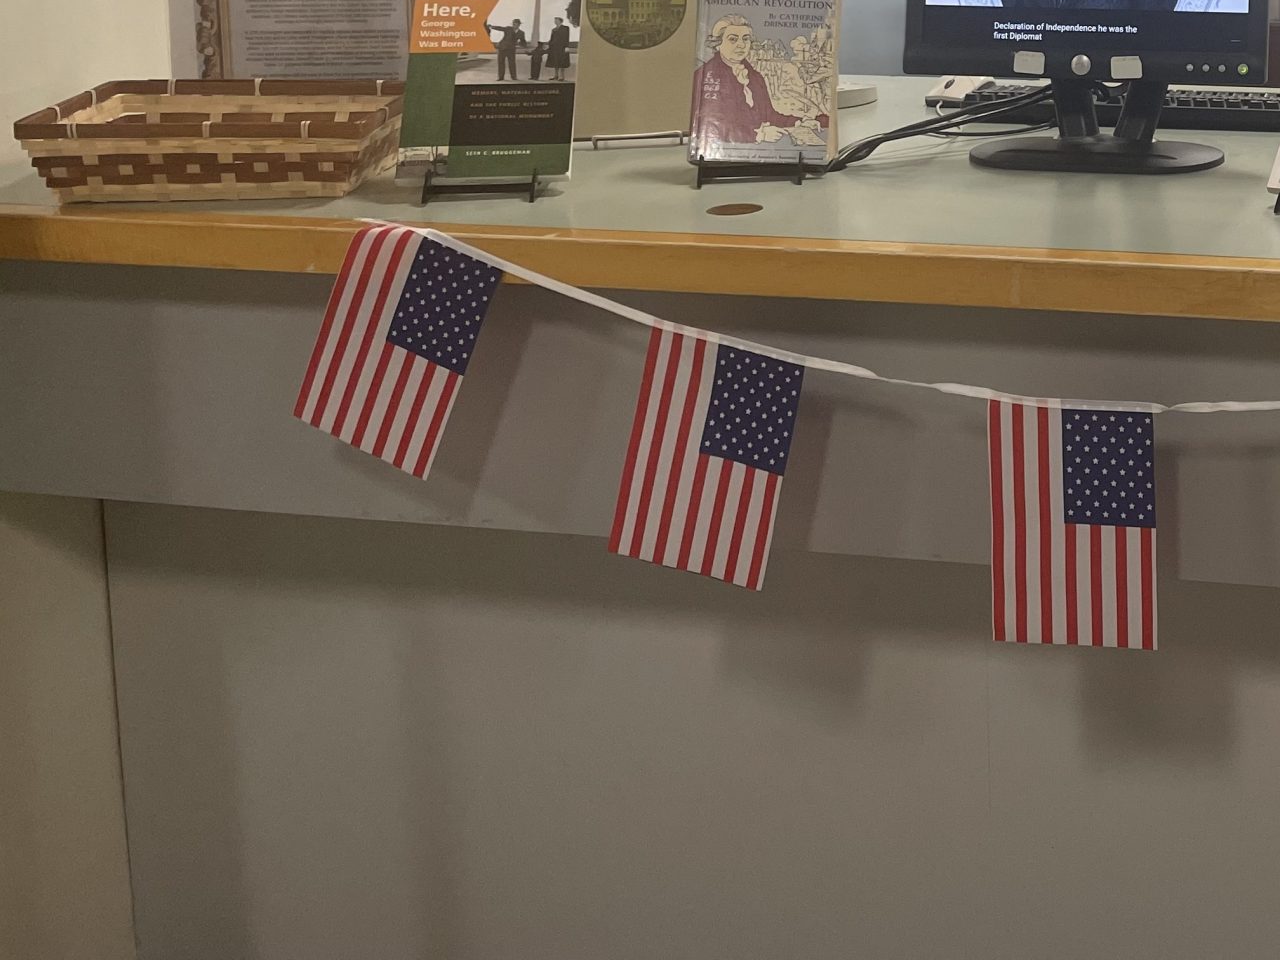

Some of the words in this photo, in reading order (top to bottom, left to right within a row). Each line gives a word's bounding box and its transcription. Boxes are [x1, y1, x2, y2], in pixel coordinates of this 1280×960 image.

[764, 0, 833, 10] REVOLUTION
[423, 3, 476, 18] Here,
[421, 20, 455, 28] George
[993, 22, 1035, 31] Declaration
[1036, 22, 1045, 30] of
[1046, 23, 1096, 32] Independence
[1098, 24, 1107, 32] he
[1125, 25, 1138, 33] the
[420, 30, 476, 39] Washington
[1009, 32, 1042, 41] Diplomat
